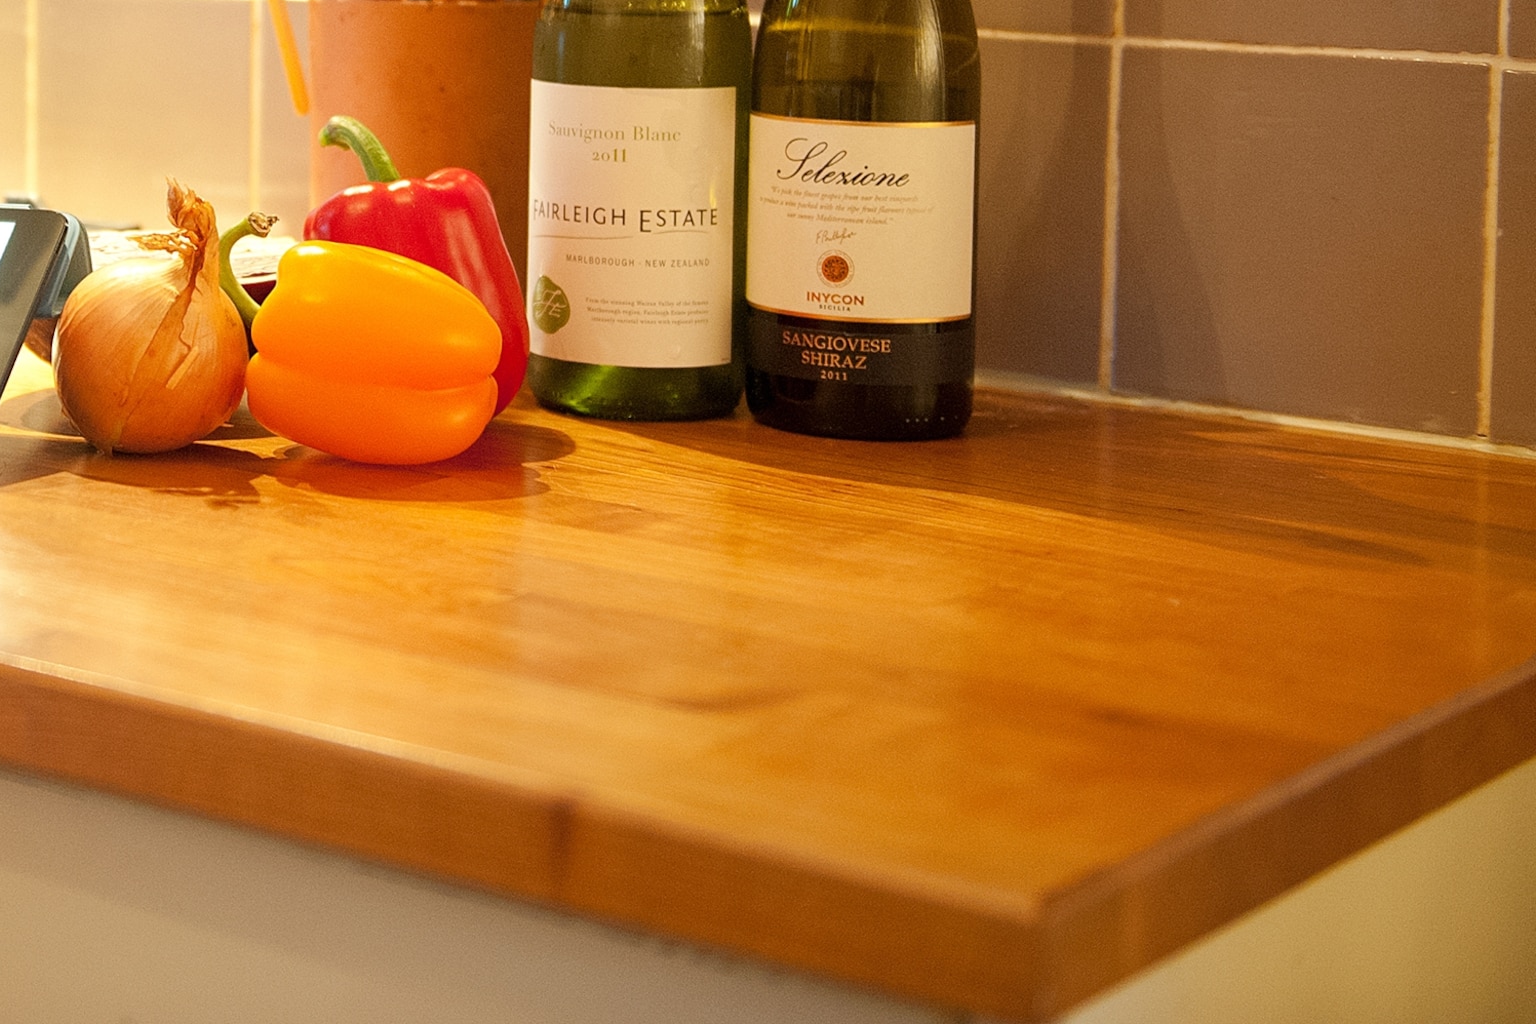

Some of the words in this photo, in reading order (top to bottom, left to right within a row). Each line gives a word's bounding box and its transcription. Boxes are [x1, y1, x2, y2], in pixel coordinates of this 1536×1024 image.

[549, 121, 625, 144] Sauvignon
[633, 125, 681, 142] Blanc
[591, 148, 626, 163] 2011
[776, 137, 910, 188] Selezione
[533, 199, 626, 226] FAIRLEIGH
[639, 208, 718, 233] ESTATE
[565, 254, 635, 267] MARLBOROUGH
[645, 259, 667, 268] NEW
[670, 258, 710, 269] ZEALAND
[806, 291, 865, 306] INYCON
[819, 304, 851, 312] SICILIA
[782, 331, 891, 353] SANGIOVESE
[801, 350, 867, 369] SHIRAZ
[820, 370, 848, 381] 2011
